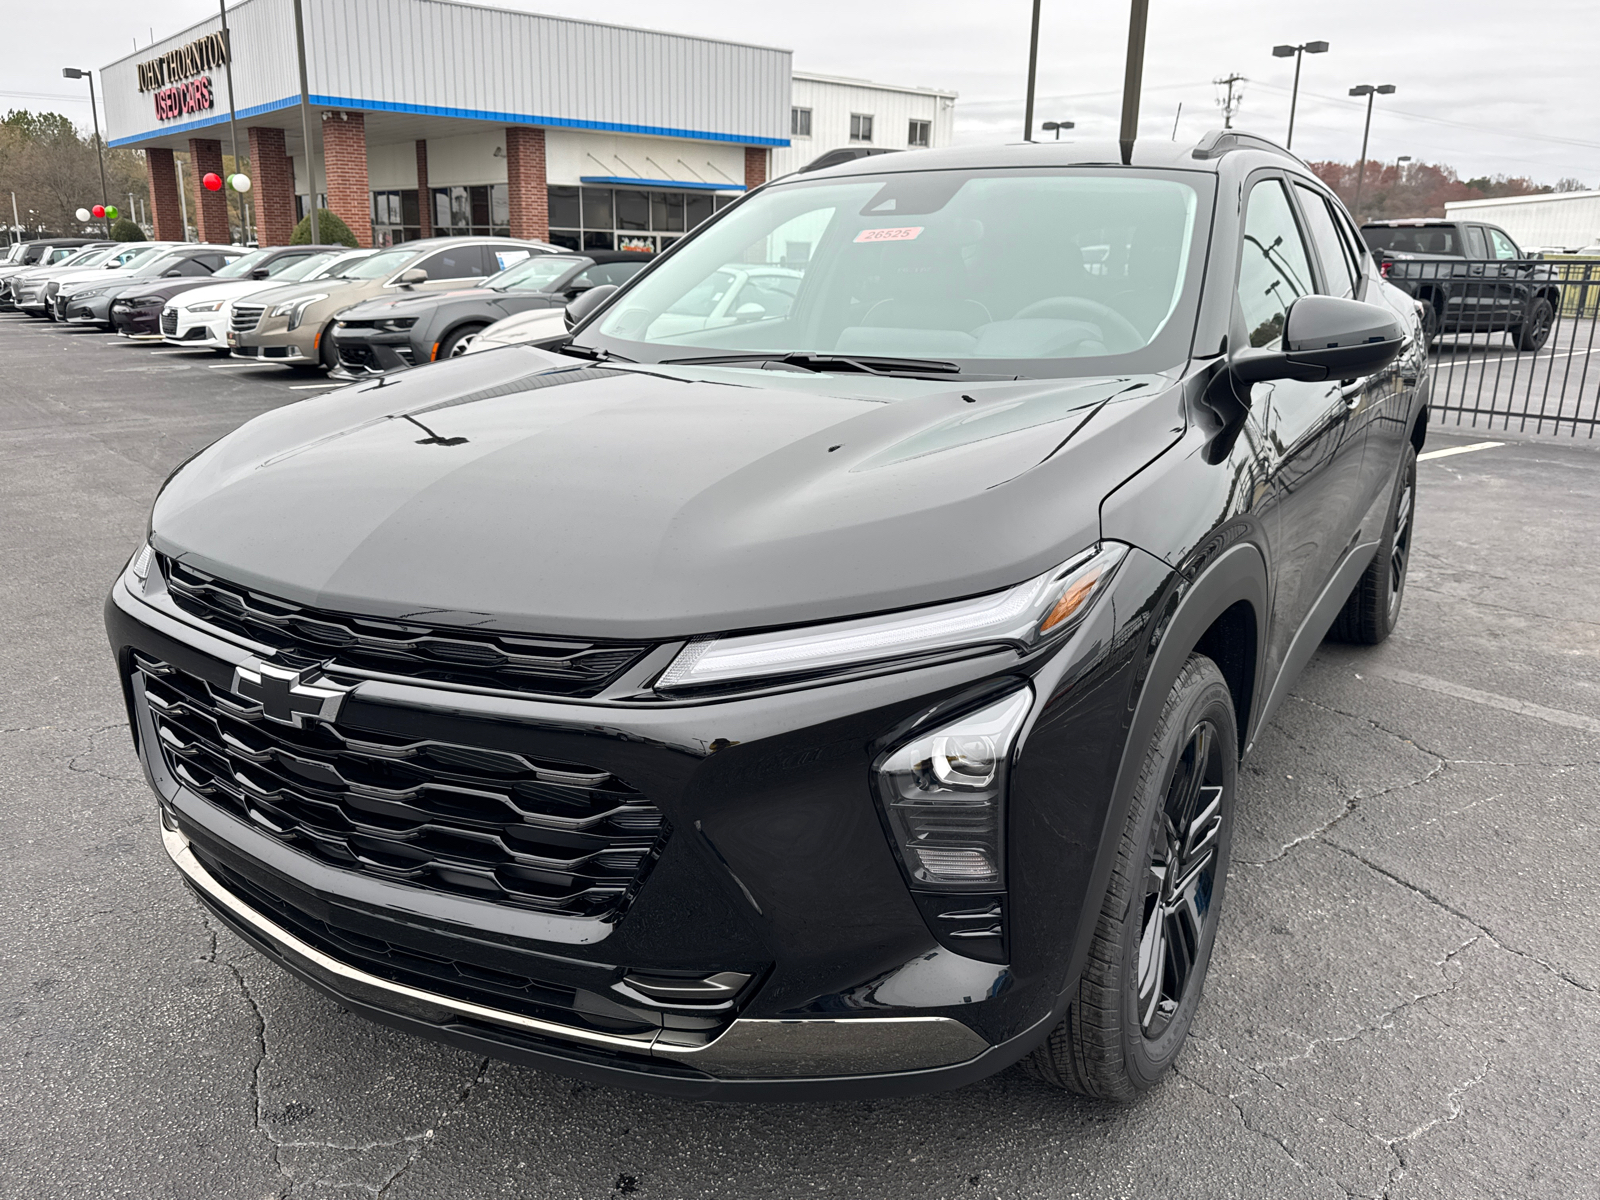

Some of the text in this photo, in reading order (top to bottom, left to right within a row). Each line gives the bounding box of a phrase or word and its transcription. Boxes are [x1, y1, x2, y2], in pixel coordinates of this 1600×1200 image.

[136, 28, 230, 92] JOHN THORNTON
[154, 76, 211, 120] USED CARS
[864, 229, 911, 240] 26525
